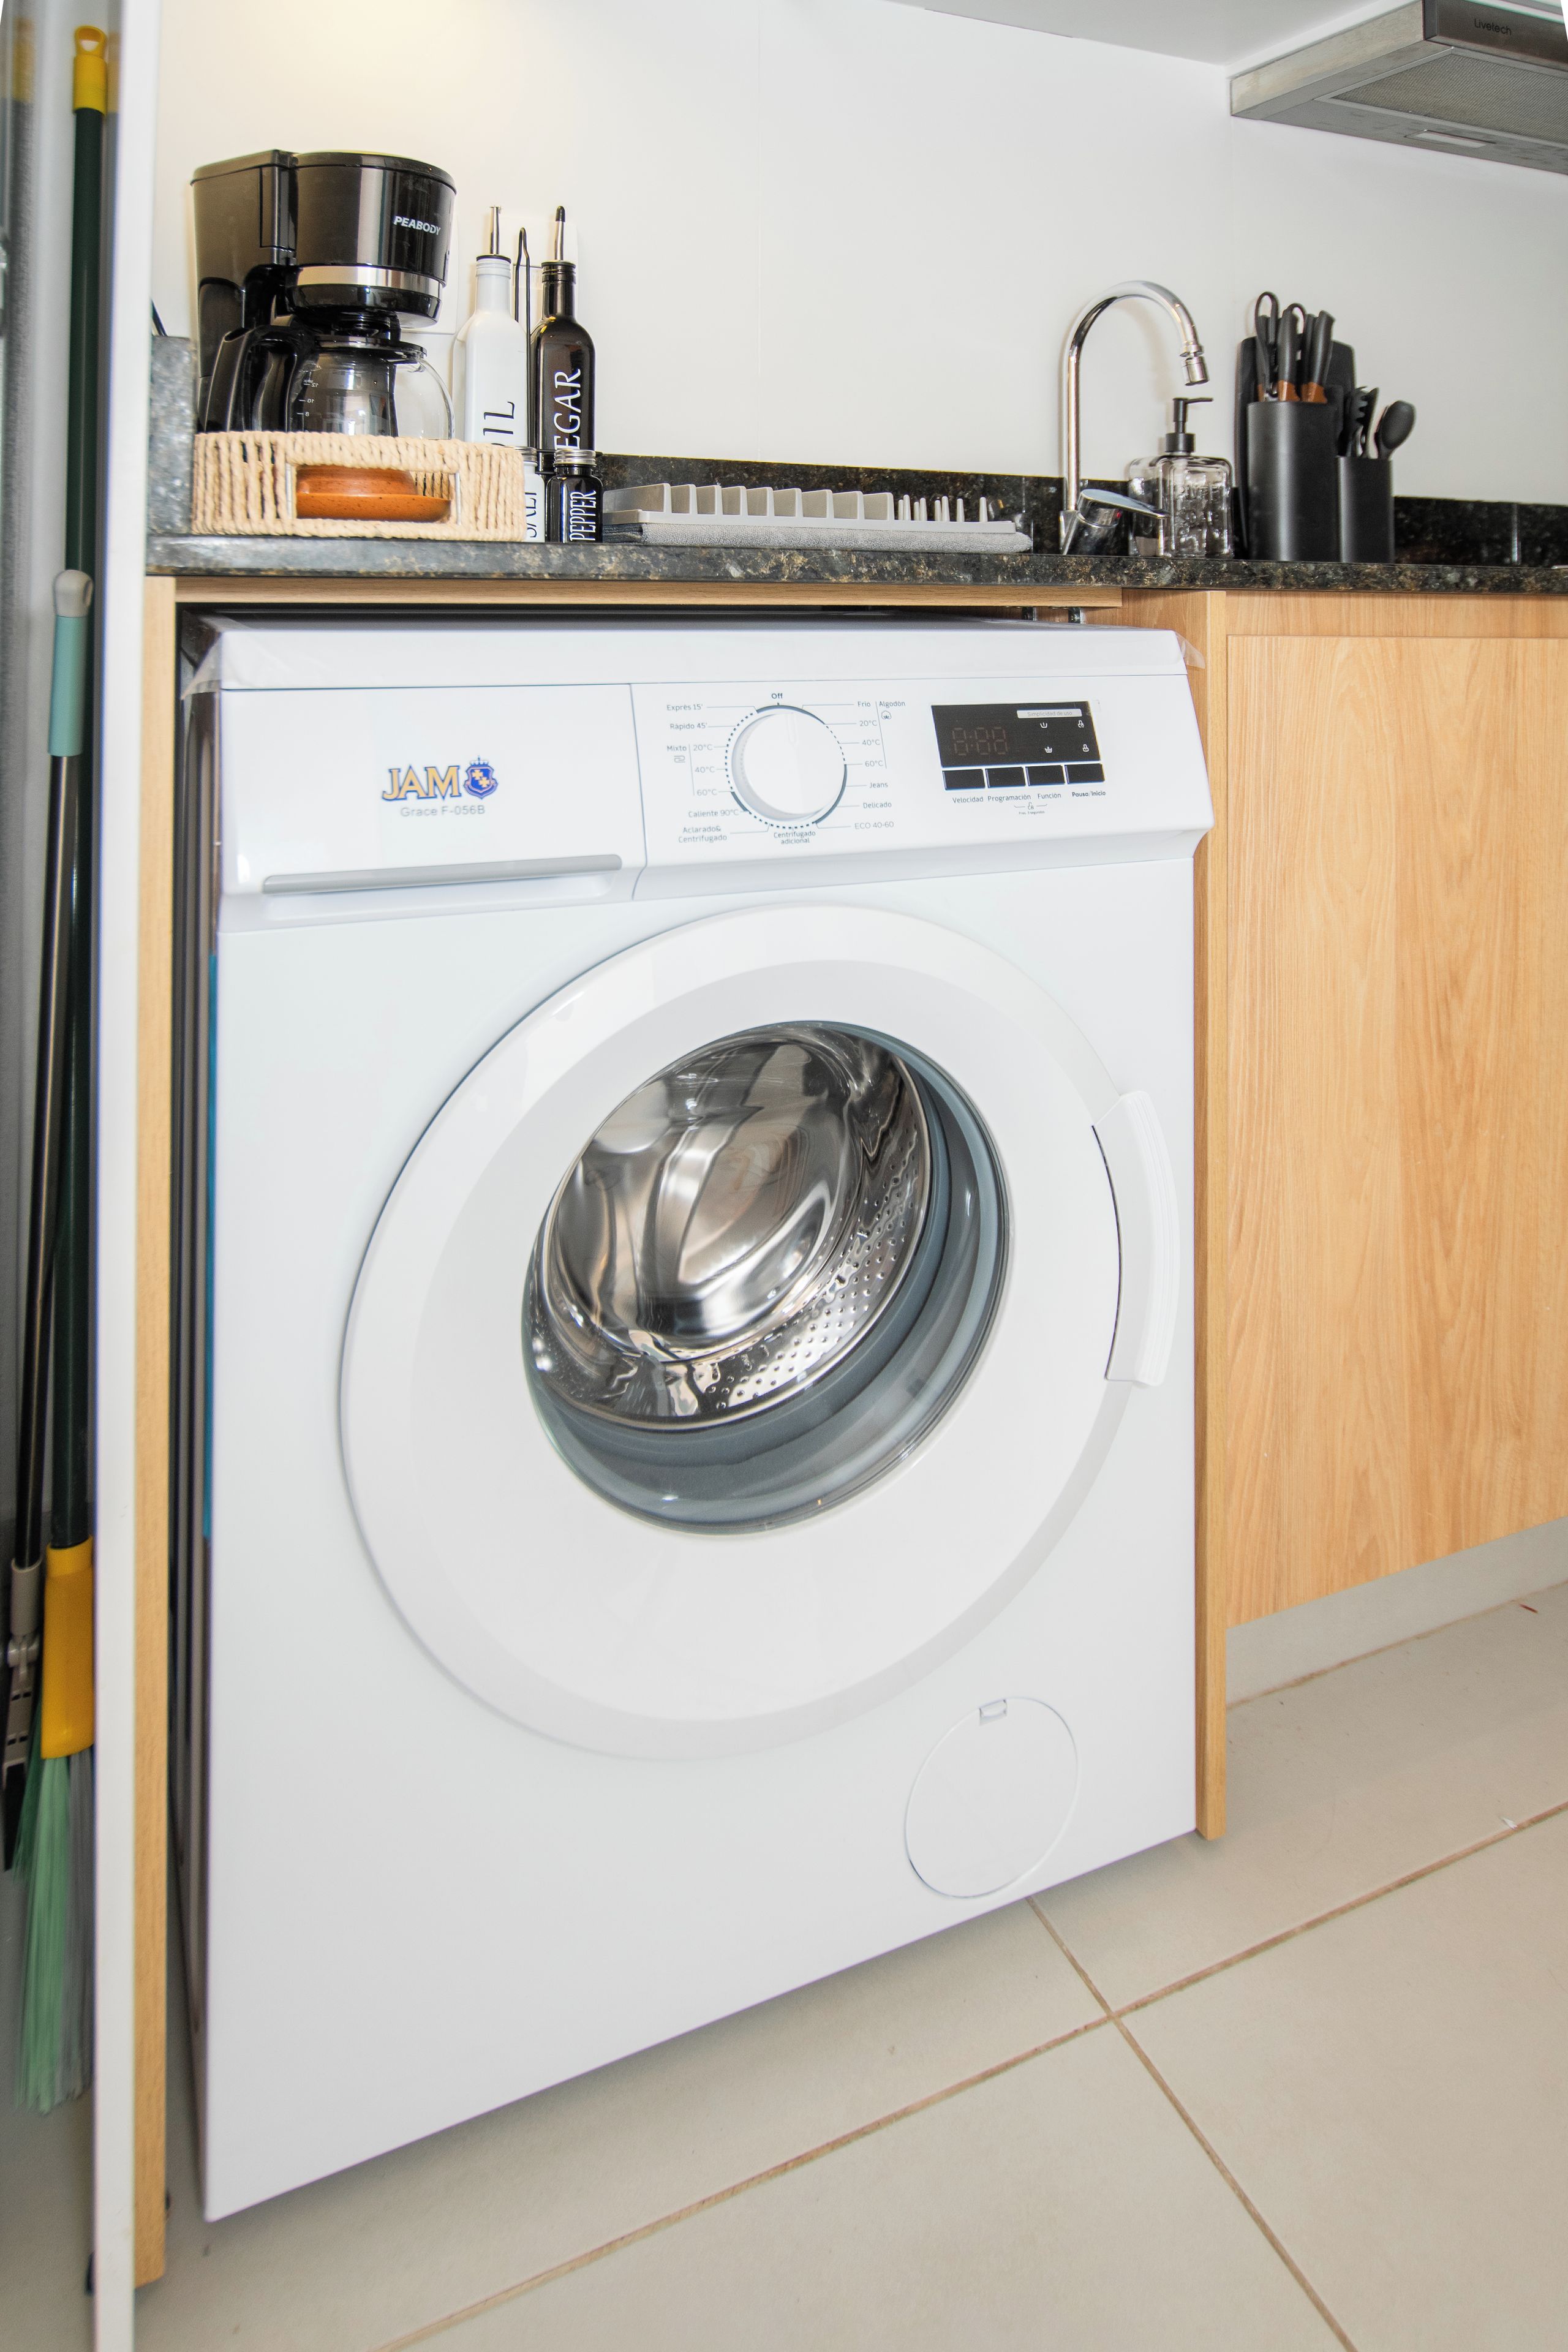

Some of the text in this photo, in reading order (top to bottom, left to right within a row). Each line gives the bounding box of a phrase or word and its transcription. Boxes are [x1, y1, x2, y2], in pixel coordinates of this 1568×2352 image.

[1474, 18, 1512, 36] Livetech
[393, 216, 441, 235] PEABODY
[483, 401, 514, 446] IL
[570, 490, 597, 541] PEPPER
[382, 764, 462, 801] JAM
[987, 794, 1031, 803] Programación
[400, 805, 486, 817] Grace F-056B
[678, 834, 728, 843] Centrifugado
